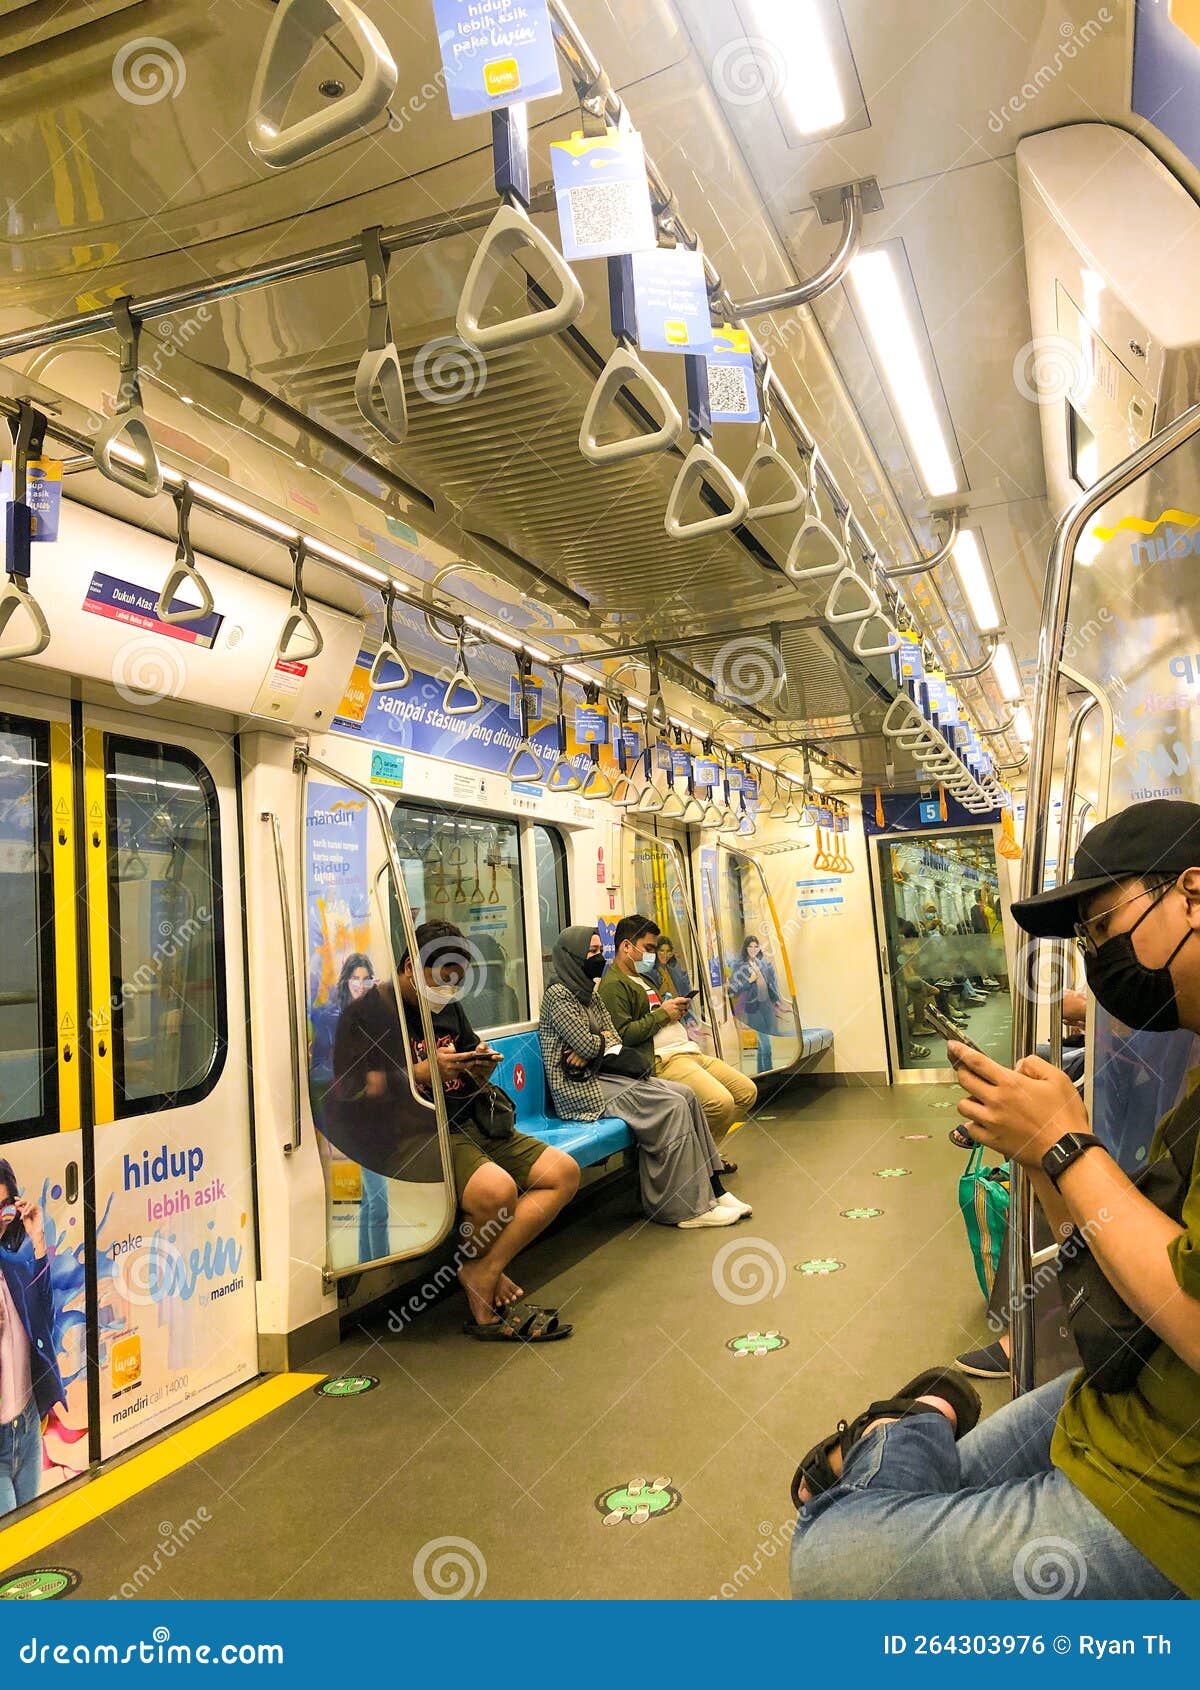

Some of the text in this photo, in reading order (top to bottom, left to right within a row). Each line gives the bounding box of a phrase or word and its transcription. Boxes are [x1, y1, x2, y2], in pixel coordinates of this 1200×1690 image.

[457, 7, 529, 34] lebih asik
[112, 588, 136, 605] Dukuh
[136, 596, 153, 611] Atas
[376, 695, 427, 722] sampai
[425, 708, 467, 734] stasiun
[465, 722, 494, 746] yang
[542, 744, 561, 762] tari
[926, 804, 936, 819] 5
[123, 1145, 204, 1191] hidup
[147, 1178, 226, 1222] lebih asik
[112, 1233, 143, 1261] pake
[210, 1276, 244, 1300] mandiri
[112, 1394, 148, 1424] mandiri
[149, 1387, 163, 1405] call
[165, 1374, 189, 1396] 14000
